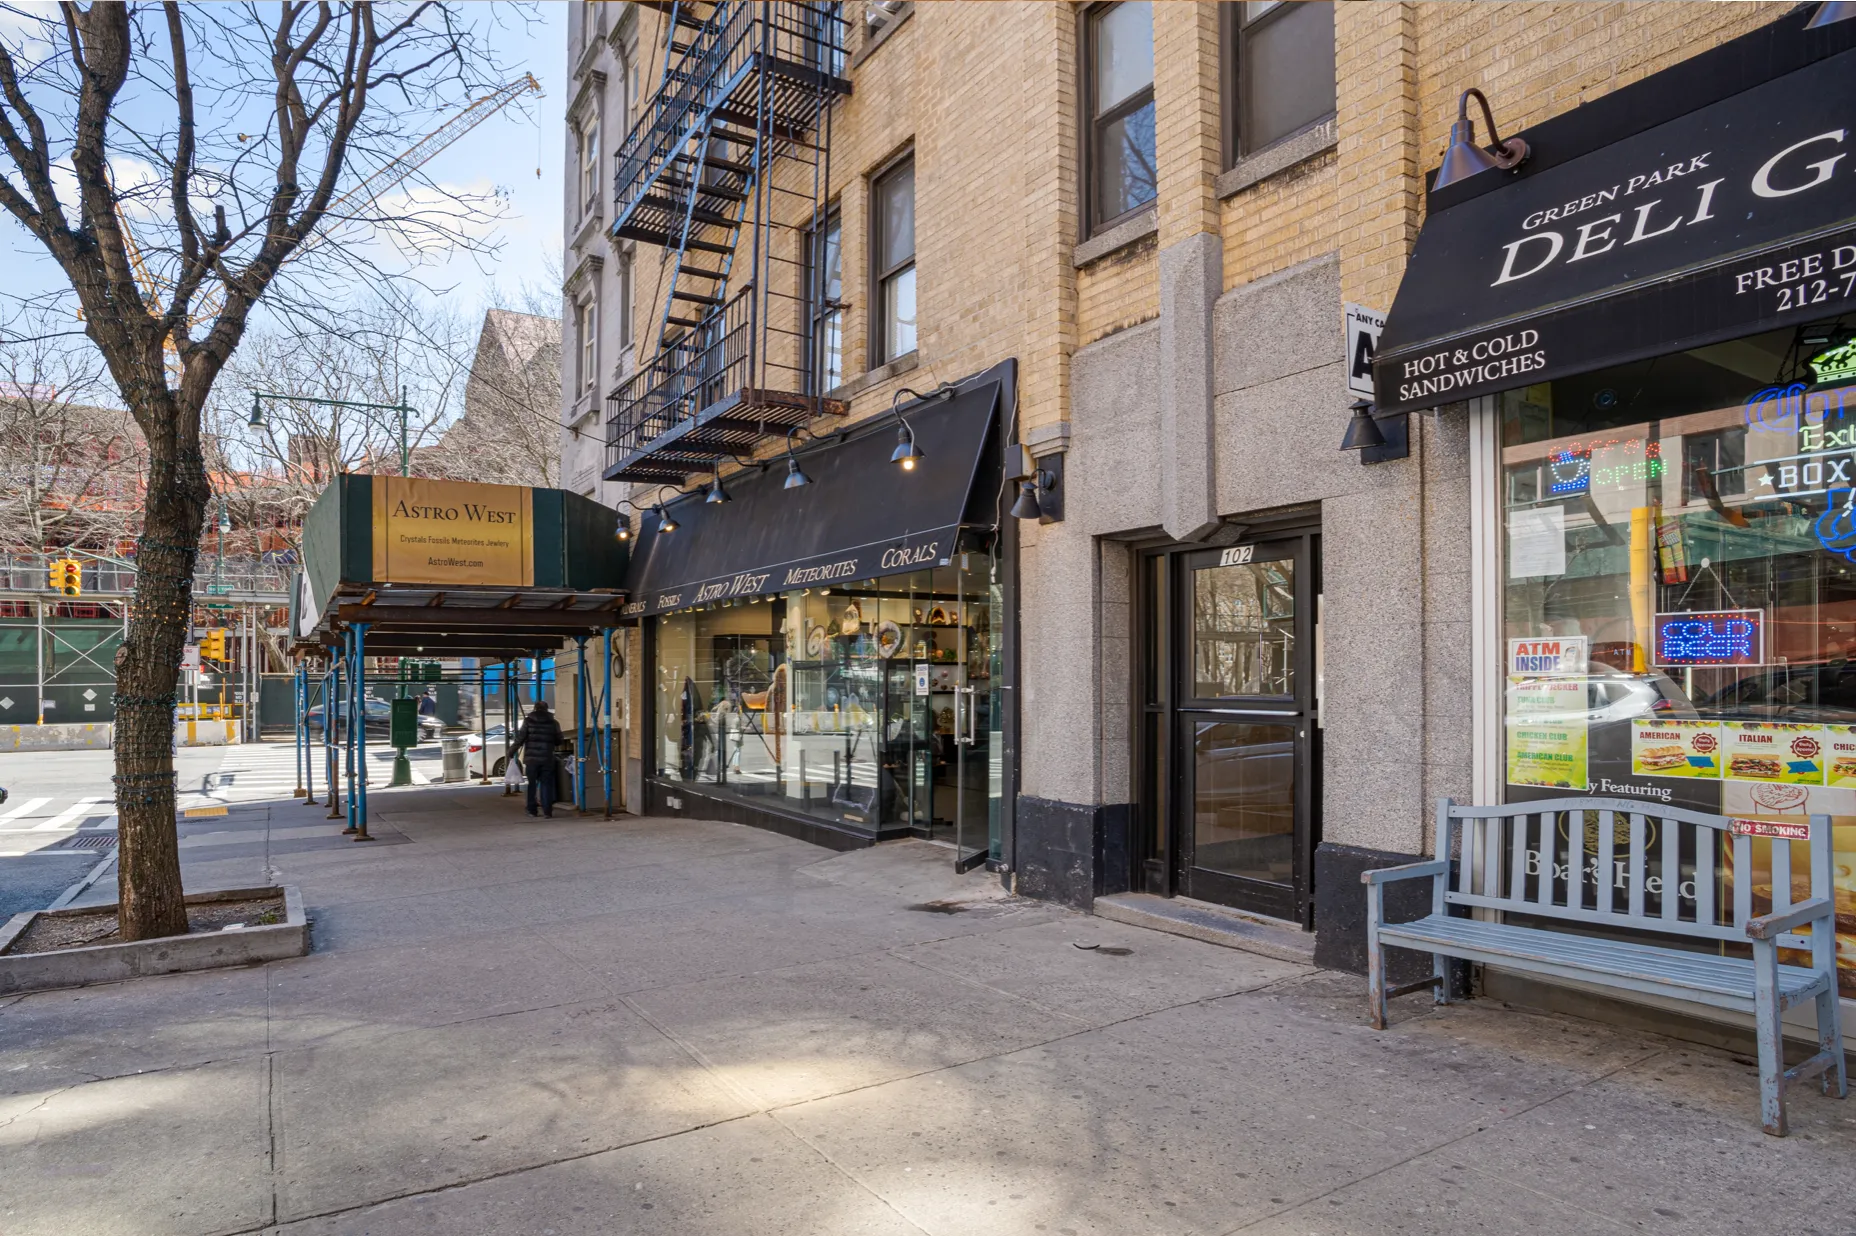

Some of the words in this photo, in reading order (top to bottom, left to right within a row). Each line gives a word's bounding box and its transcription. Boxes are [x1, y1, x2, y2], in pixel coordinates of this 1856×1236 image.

[1522, 184, 1620, 230] GREEN
[1623, 152, 1712, 196] PARK
[1489, 178, 1725, 287] DELI
[1735, 253, 1823, 295] FREE
[1356, 313, 1374, 326] ANY
[1403, 351, 1440, 379] HOT
[1452, 349, 1469, 365] &
[1472, 329, 1539, 361] COLD
[1399, 350, 1546, 401] SANDWICHES
[1595, 459, 1669, 485] OPEN
[1778, 459, 1851, 489] BOX
[400, 534, 427, 544] Crystals
[428, 535, 450, 545] Fossils
[451, 538, 485, 546] Meteorites
[428, 557, 484, 568] AstroWest.com
[783, 559, 859, 586] METEORITES
[881, 542, 939, 569] CORALS
[1225, 547, 1251, 565] 102
[1662, 620, 1753, 640] COLD
[1516, 642, 1561, 656] ATM
[1663, 640, 1751, 657] BEER
[1516, 656, 1562, 672] INSIDE
[1516, 731, 1548, 740] CHICKEN
[1549, 732, 1568, 741] CLUB
[1640, 731, 1681, 741] AMERICAN
[1739, 734, 1773, 744] ITALIAN
[1516, 752, 1553, 761] AMERICAN
[1554, 754, 1574, 762] CLUB
[1601, 778, 1673, 802] Featuring
[1755, 823, 1806, 837] SMOKING
